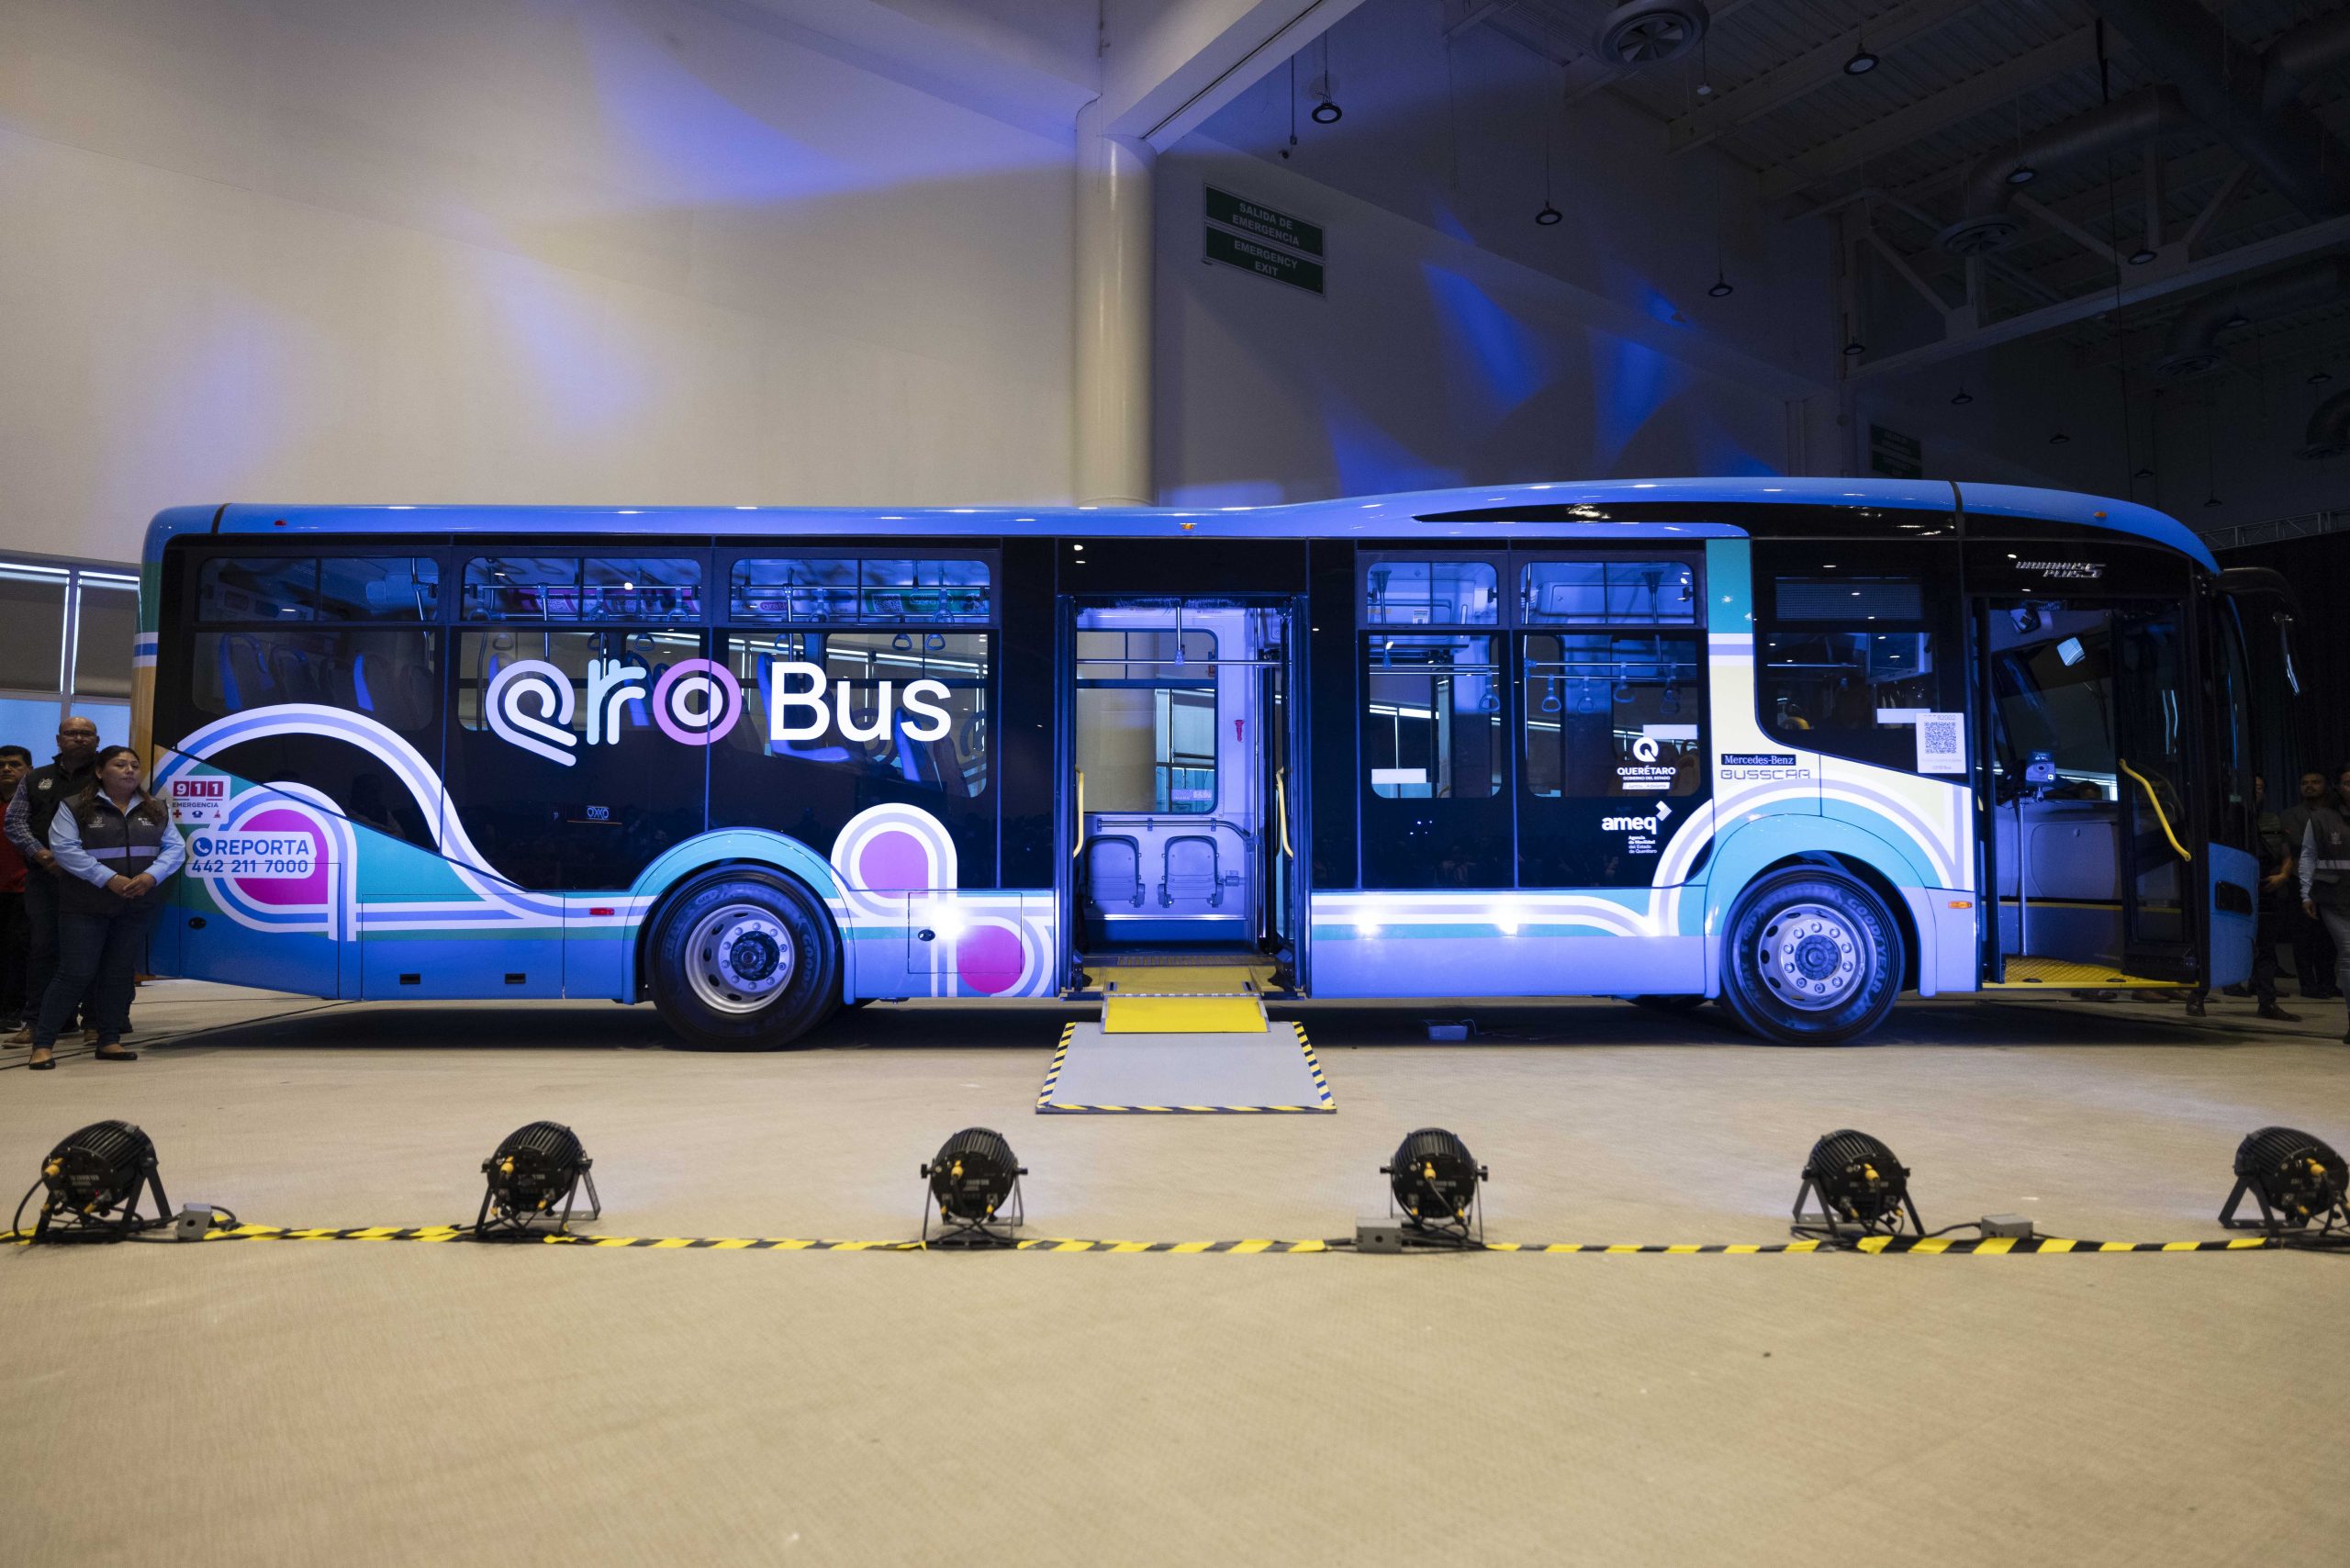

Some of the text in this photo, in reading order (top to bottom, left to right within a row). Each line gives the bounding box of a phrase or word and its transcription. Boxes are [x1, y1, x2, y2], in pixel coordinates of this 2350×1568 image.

[1239, 203, 1292, 230] SALIDA DE
[1232, 214, 1299, 246] EMERGENCIA
[1234, 240, 1298, 269] EMERGENCY
[1255, 262, 1278, 276] EXIT
[771, 662, 952, 742] Bus
[1724, 755, 1794, 765] Mercedes-Benz
[1617, 765, 1676, 775] QUERÉTARO
[1720, 769, 1810, 779] BUSSCAR
[174, 782, 222, 796] 911
[1602, 816, 1657, 834] ameq
[215, 839, 308, 855] REPORTA
[192, 859, 308, 873] 442 211 7000
[1847, 898, 1888, 995] GOODYEAR
